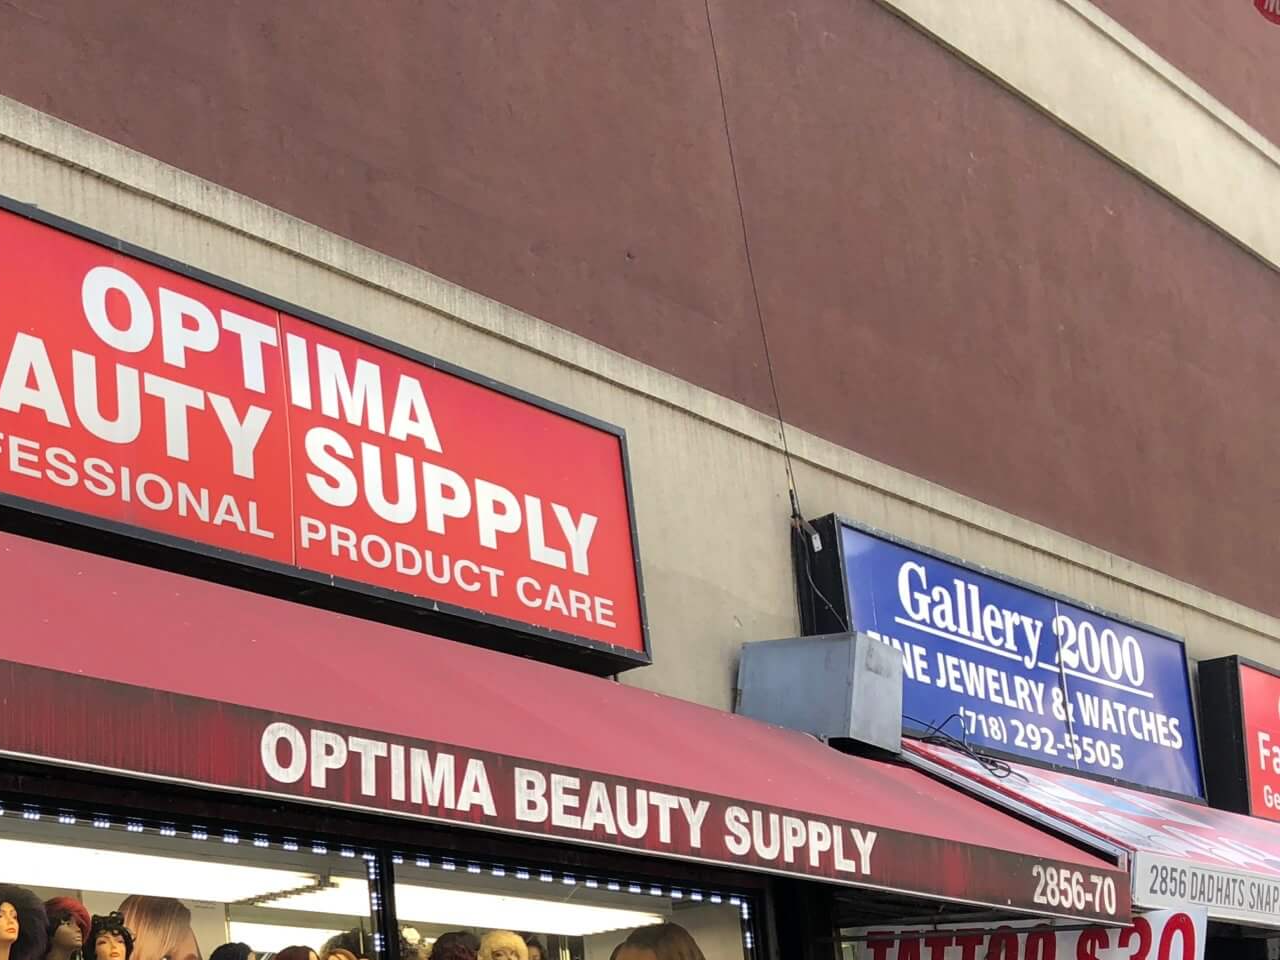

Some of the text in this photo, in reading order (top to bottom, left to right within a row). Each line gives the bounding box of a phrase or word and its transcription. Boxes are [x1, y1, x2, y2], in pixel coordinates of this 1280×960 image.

[82, 266, 443, 453] OPTIMA
[303, 427, 598, 577] SUPPLY
[300, 515, 505, 600] PRODUCT
[516, 575, 617, 628] CARE
[898, 561, 1145, 687] Gallery 2000
[867, 630, 1184, 751] NE JEWELRY & WATCHES
[1010, 719, 1125, 771] 292-5505
[260, 721, 878, 876] OPTIMA BEAUTY SUPPLY
[1032, 864, 1116, 916] 2856-70
[1149, 864, 1187, 899] 2856
[1190, 871, 1246, 907] DADHATS
